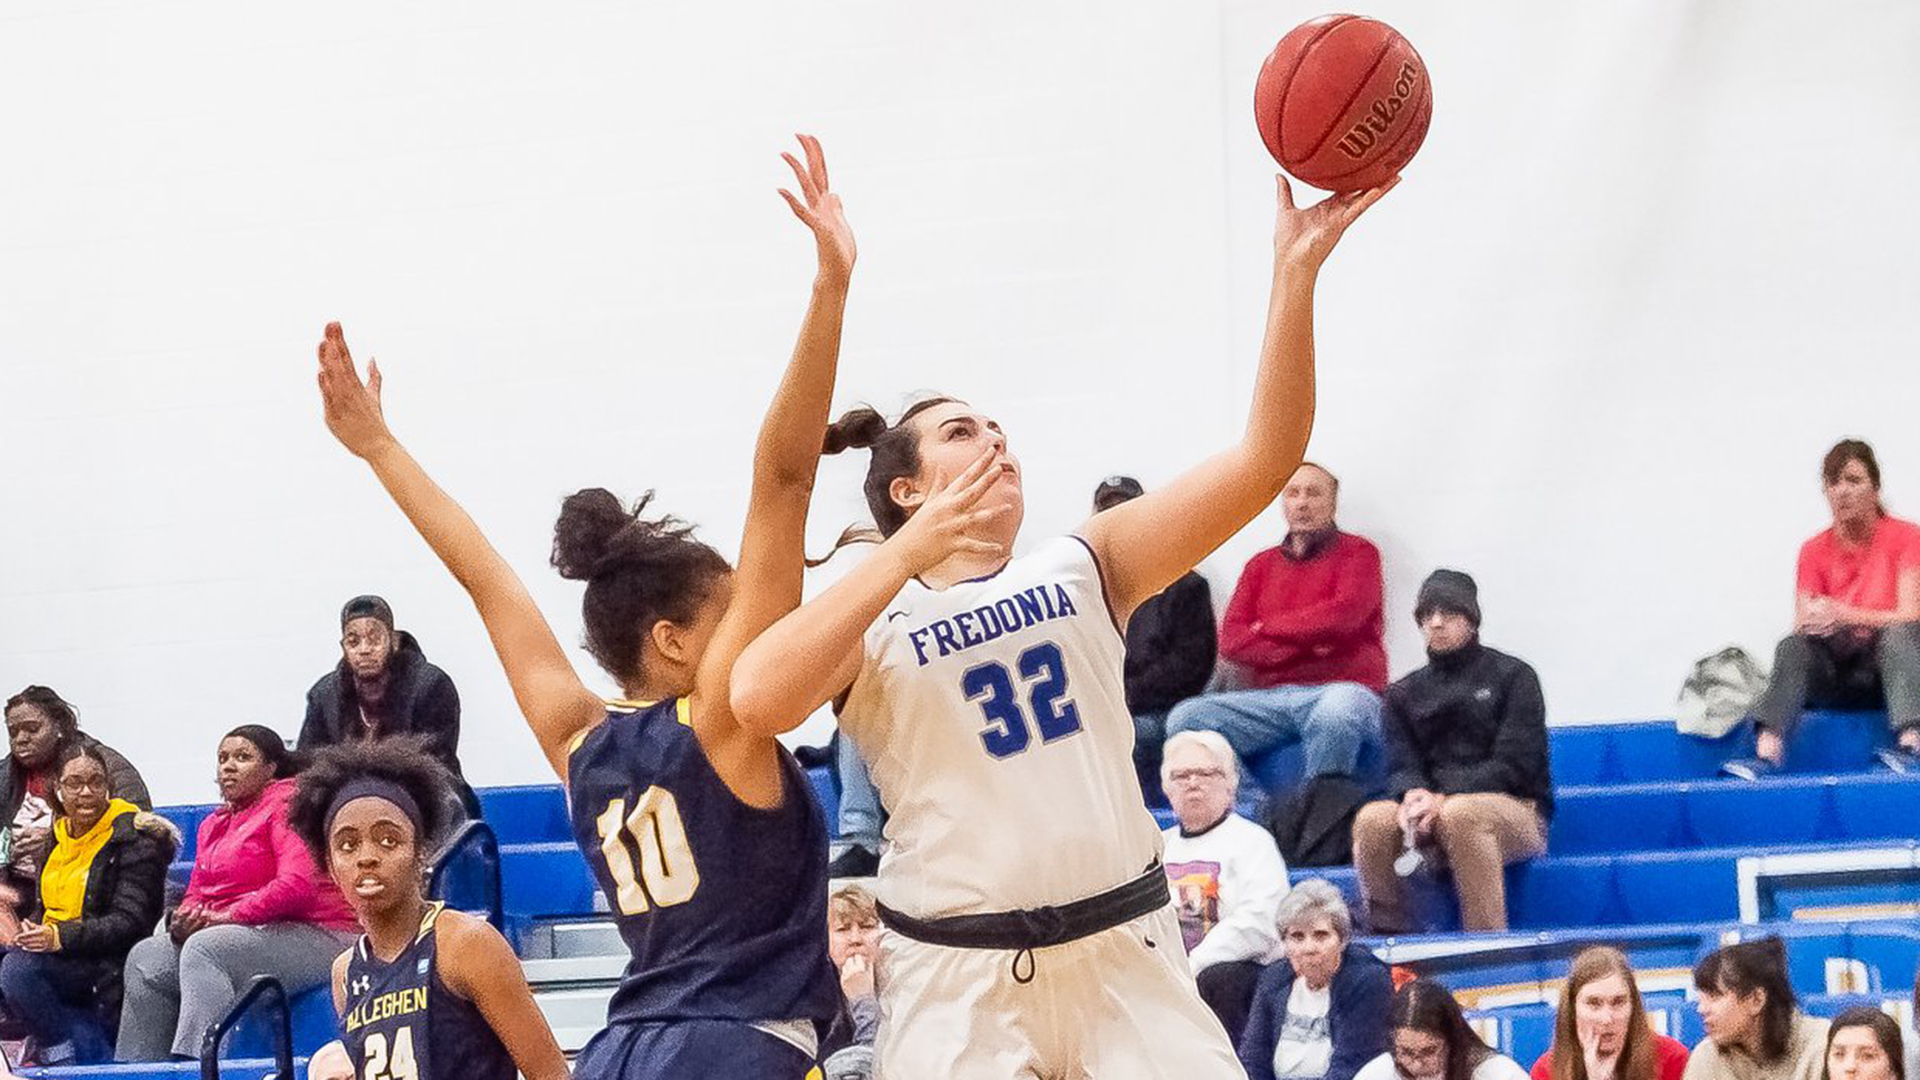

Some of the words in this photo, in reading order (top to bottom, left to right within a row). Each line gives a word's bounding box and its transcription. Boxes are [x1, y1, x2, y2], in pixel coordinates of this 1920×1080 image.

[1336, 61, 1418, 159] Wilson
[908, 583, 1077, 666] FREDONIA
[960, 640, 1084, 761] 32
[597, 785, 700, 916] 10
[364, 1026, 419, 1080] 24
